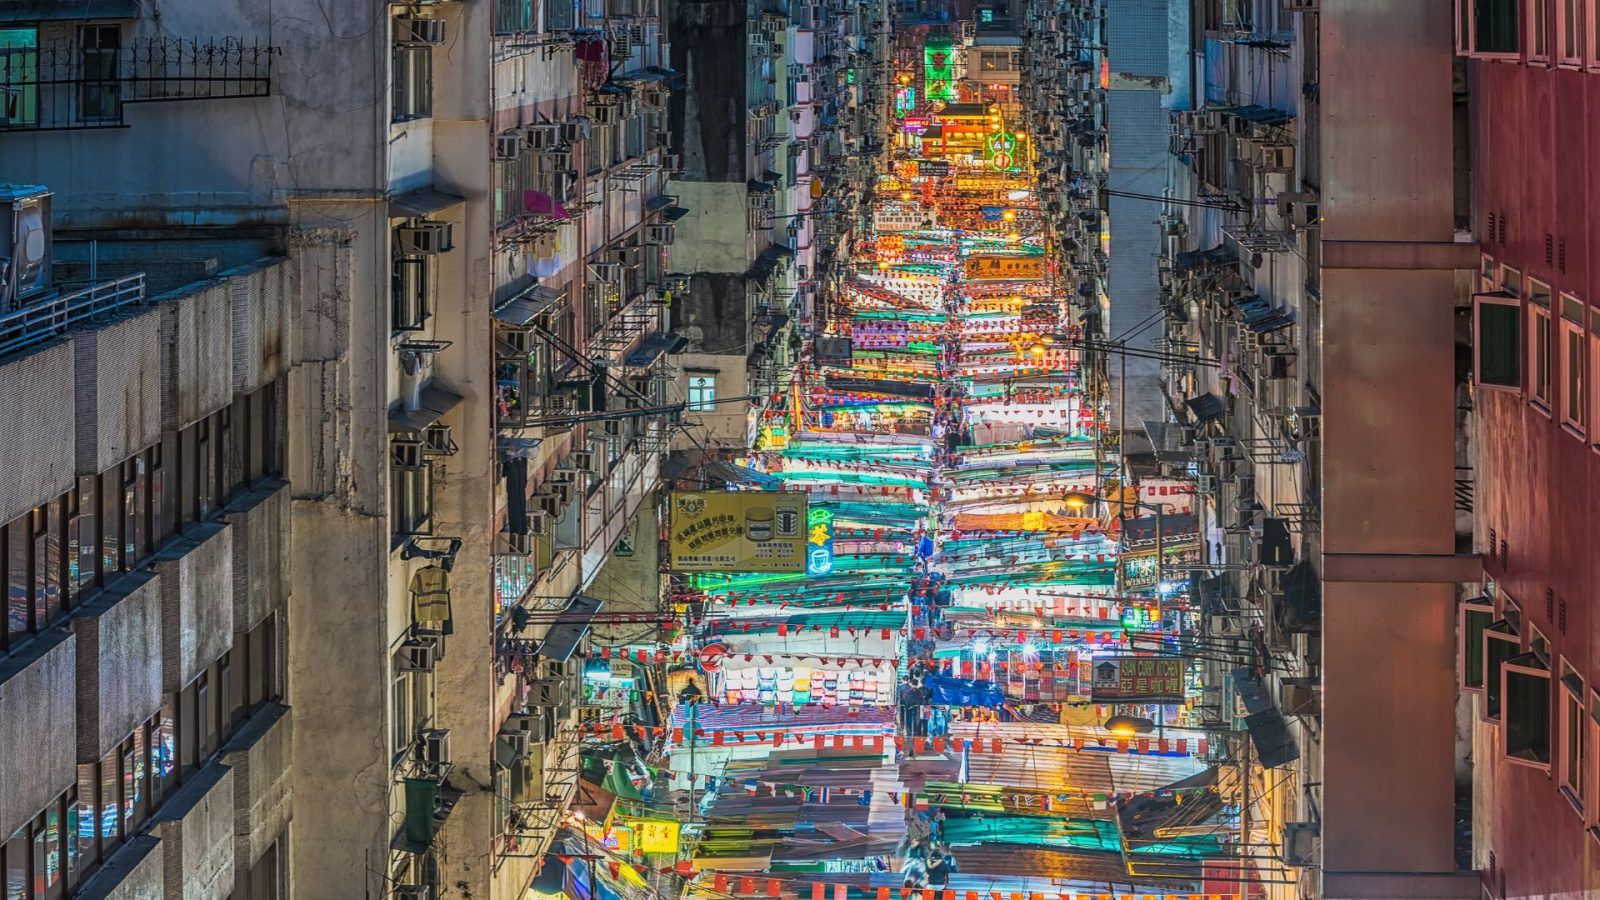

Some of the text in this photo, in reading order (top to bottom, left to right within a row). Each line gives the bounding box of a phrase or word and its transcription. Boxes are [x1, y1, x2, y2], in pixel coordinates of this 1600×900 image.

[1126, 576, 1157, 586] WINNER
[1121, 660, 1136, 676] ASIAN
[1157, 660, 1178, 676] KITCHEN
[1120, 678, 1179, 694] 亞星咖喱
